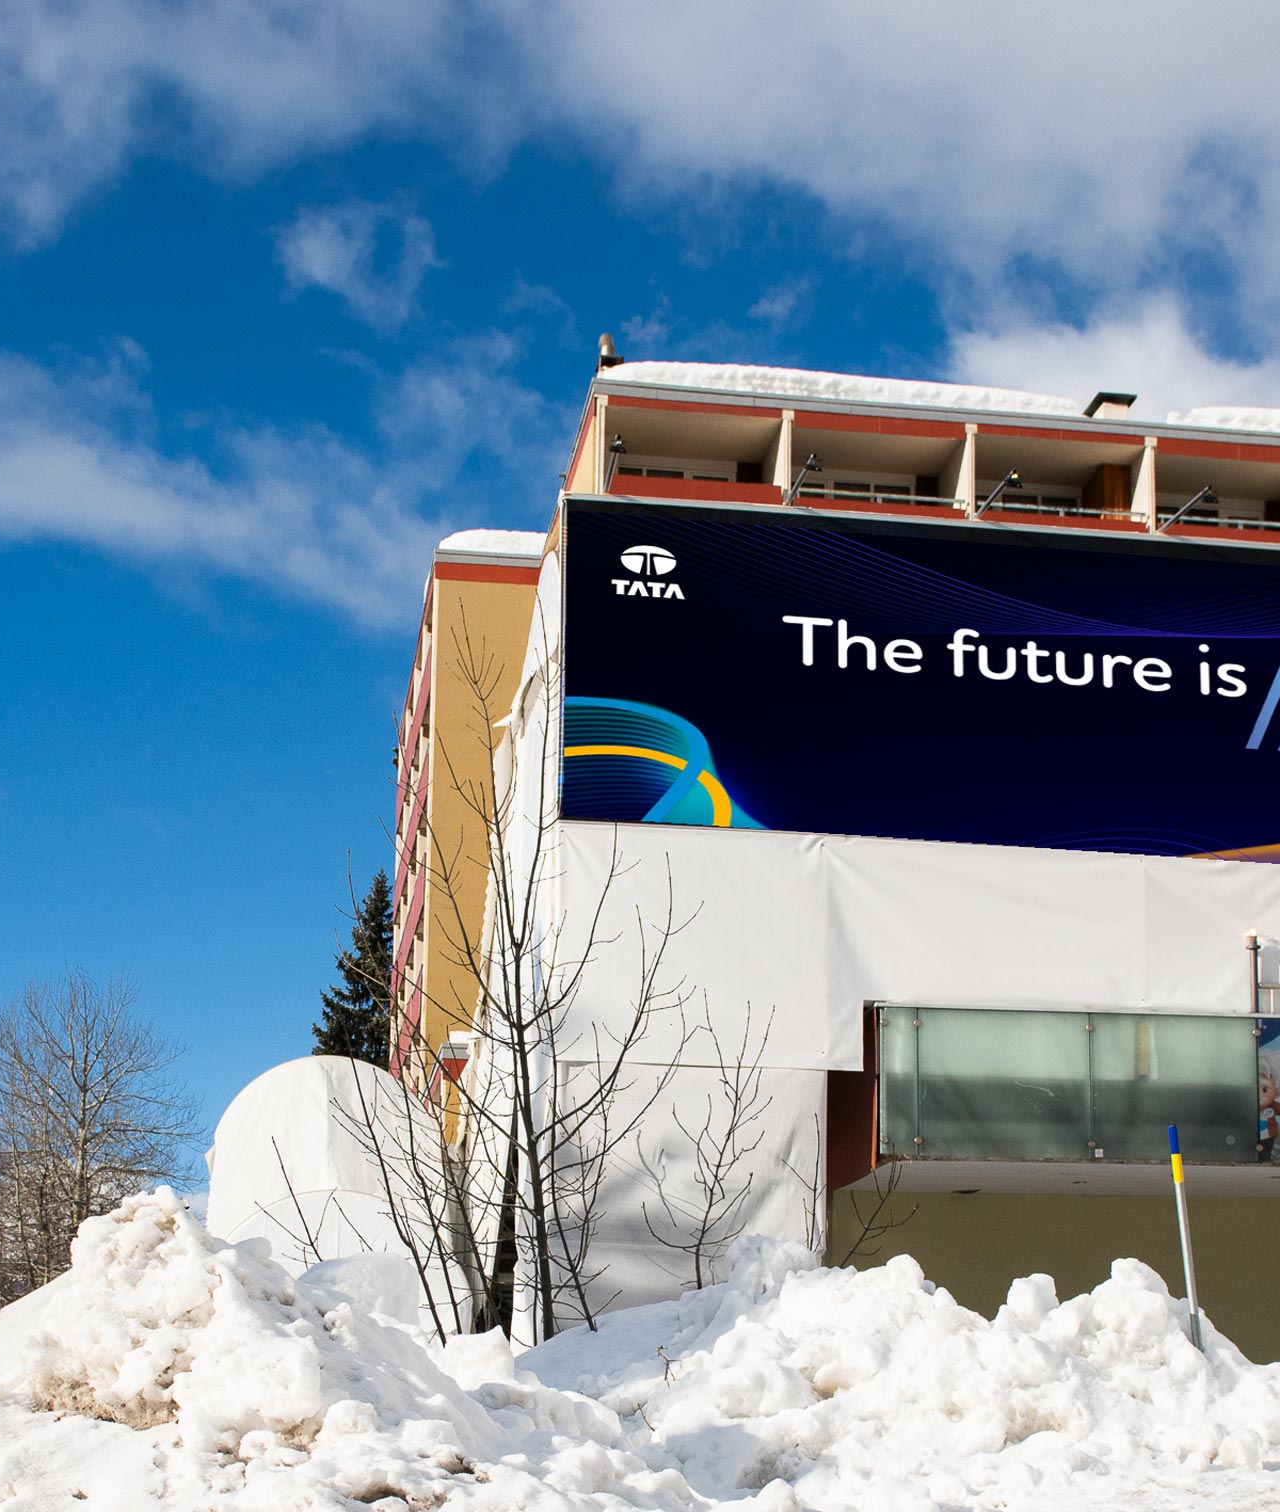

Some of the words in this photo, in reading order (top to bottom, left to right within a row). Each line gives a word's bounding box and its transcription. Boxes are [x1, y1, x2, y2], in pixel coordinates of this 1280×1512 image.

[610, 578, 686, 600] TATA
[782, 615, 923, 674] The
[946, 628, 1173, 692] future
[1198, 643, 1248, 698] is
